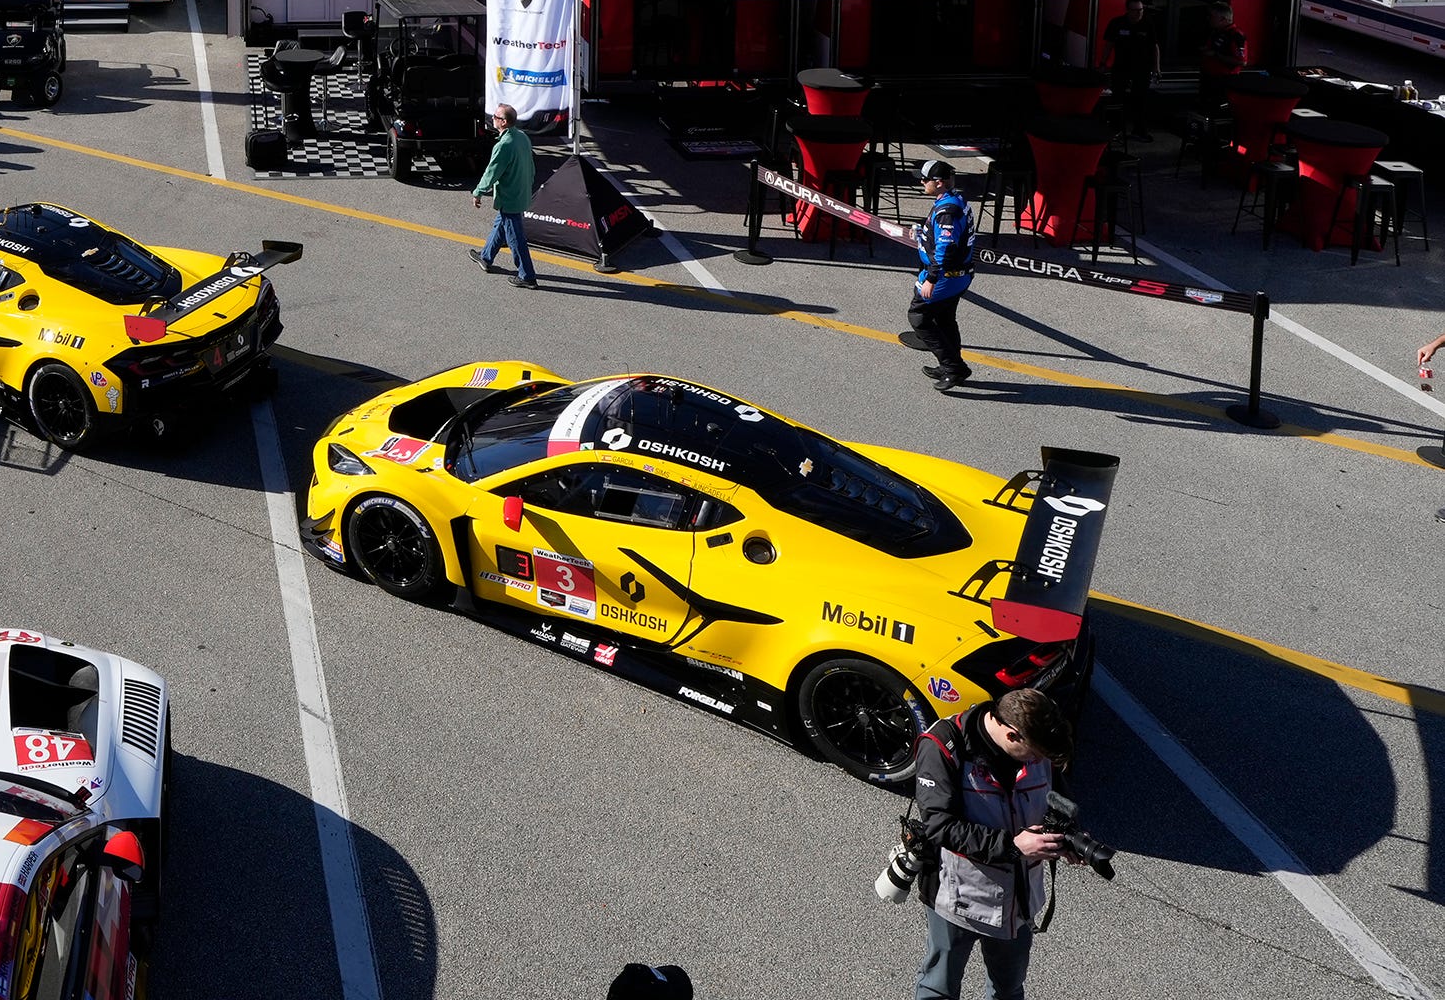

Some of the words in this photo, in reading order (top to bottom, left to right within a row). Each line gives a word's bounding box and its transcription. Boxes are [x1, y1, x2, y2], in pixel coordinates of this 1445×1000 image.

[492, 36, 567, 50] WeatherTech
[515, 73, 563, 85] MICHELIN
[774, 176, 822, 207] ACURA
[848, 209, 872, 226] S
[523, 211, 592, 231] WeatherTech
[996, 253, 1083, 282] ACURA
[1089, 270, 1133, 286] Type
[1130, 278, 1171, 296] S
[176, 275, 237, 310] OSHKOSH
[212, 347, 223, 368] 4
[611, 455, 635, 467] GARCIA
[637, 439, 726, 473] OSHKOSH
[654, 466, 671, 479] SIMS
[536, 548, 591, 567] WeatherTech
[1036, 515, 1078, 584] OSHKOSH
[509, 580, 532, 591] PRO
[555, 565, 577, 592] 3
[600, 603, 668, 633] OSHKOSH
[821, 601, 888, 636] Mobil
[678, 686, 735, 715] FORGELINE
[928, 675, 952, 701] VP
[25, 734, 76, 763] 48
[20, 761, 92, 772] WeatherTech
[917, 777, 936, 788] TRD
[21, 850, 39, 878] HARPER
